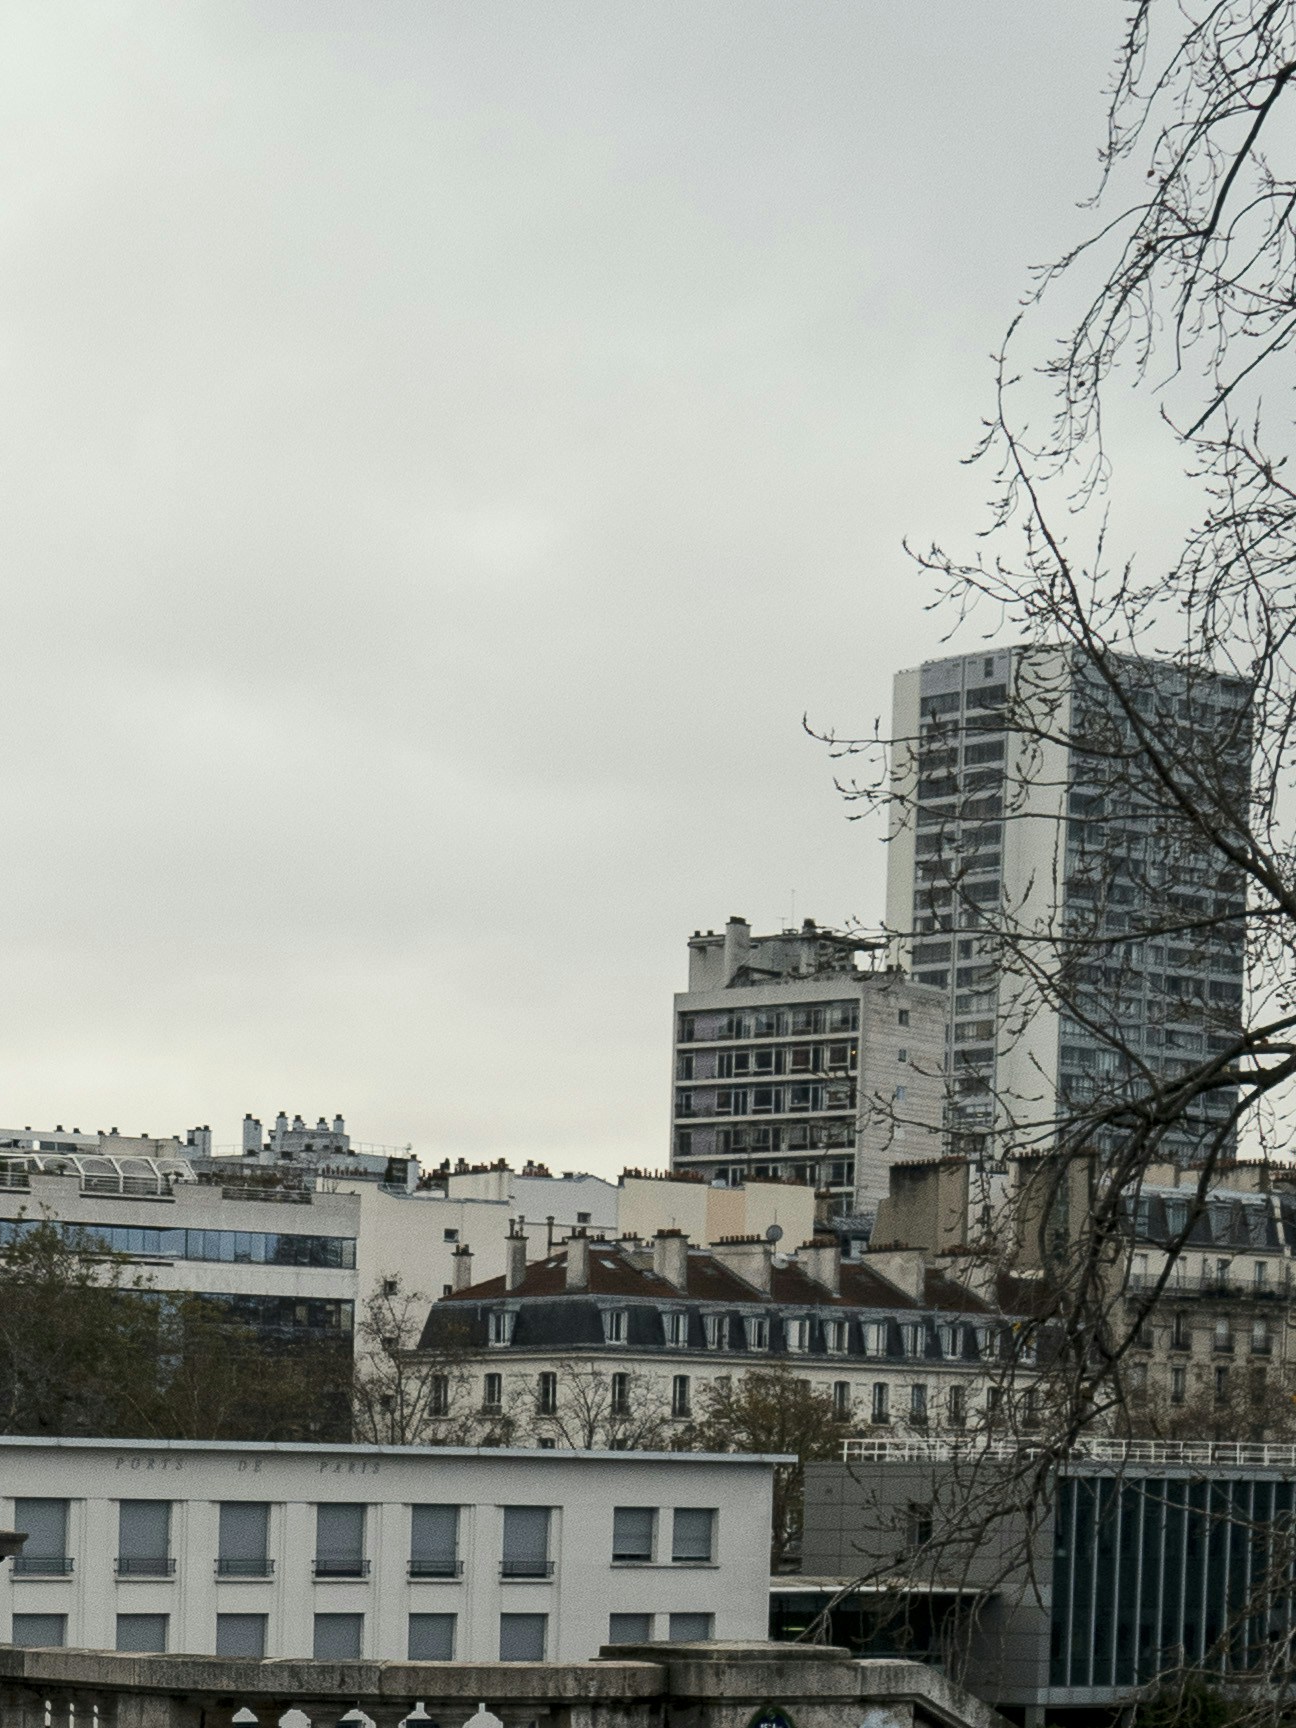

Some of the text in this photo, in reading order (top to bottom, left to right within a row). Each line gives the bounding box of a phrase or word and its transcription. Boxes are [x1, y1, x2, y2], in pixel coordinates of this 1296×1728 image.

[114, 1457, 381, 1474] PORTS DE PARIS
